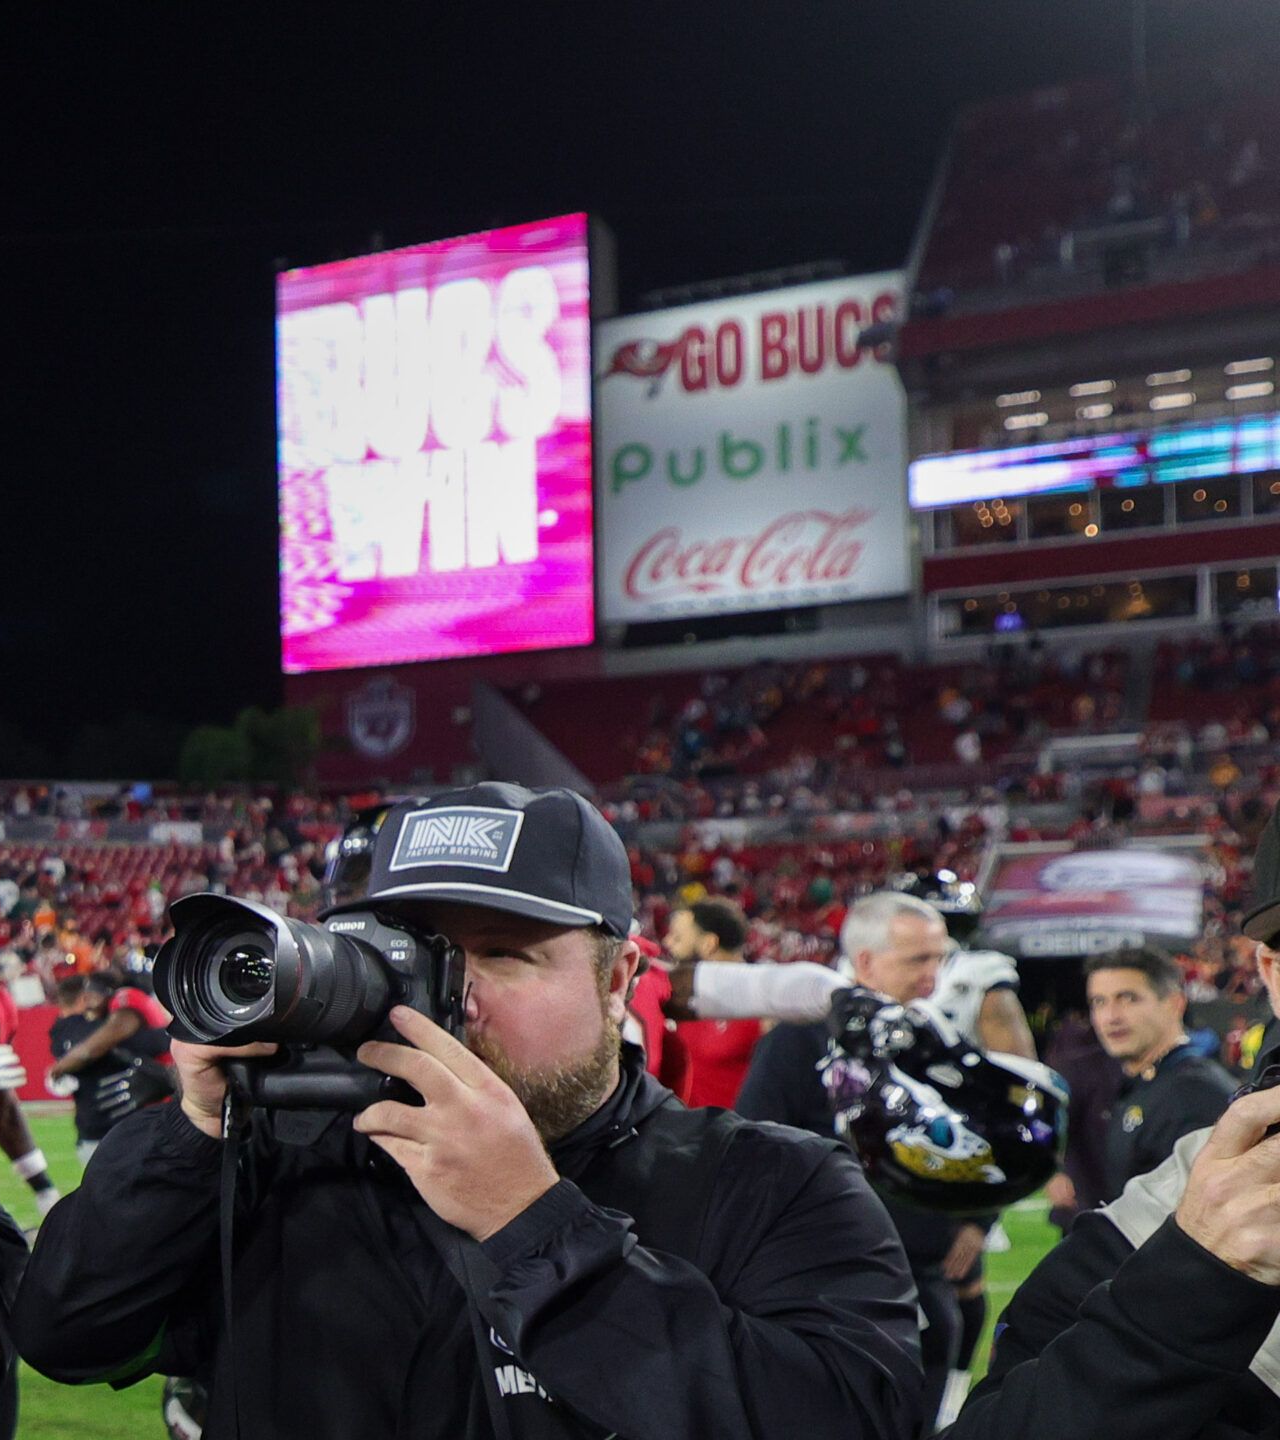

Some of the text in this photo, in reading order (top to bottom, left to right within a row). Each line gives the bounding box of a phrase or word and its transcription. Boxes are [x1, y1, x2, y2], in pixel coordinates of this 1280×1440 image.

[680, 326, 744, 393] GO
[409, 815, 507, 851] INK
[405, 846, 499, 860] FACTORY BREWING
[328, 921, 366, 932] Canon
[390, 940, 409, 948] EOS
[391, 950, 406, 960] R3
